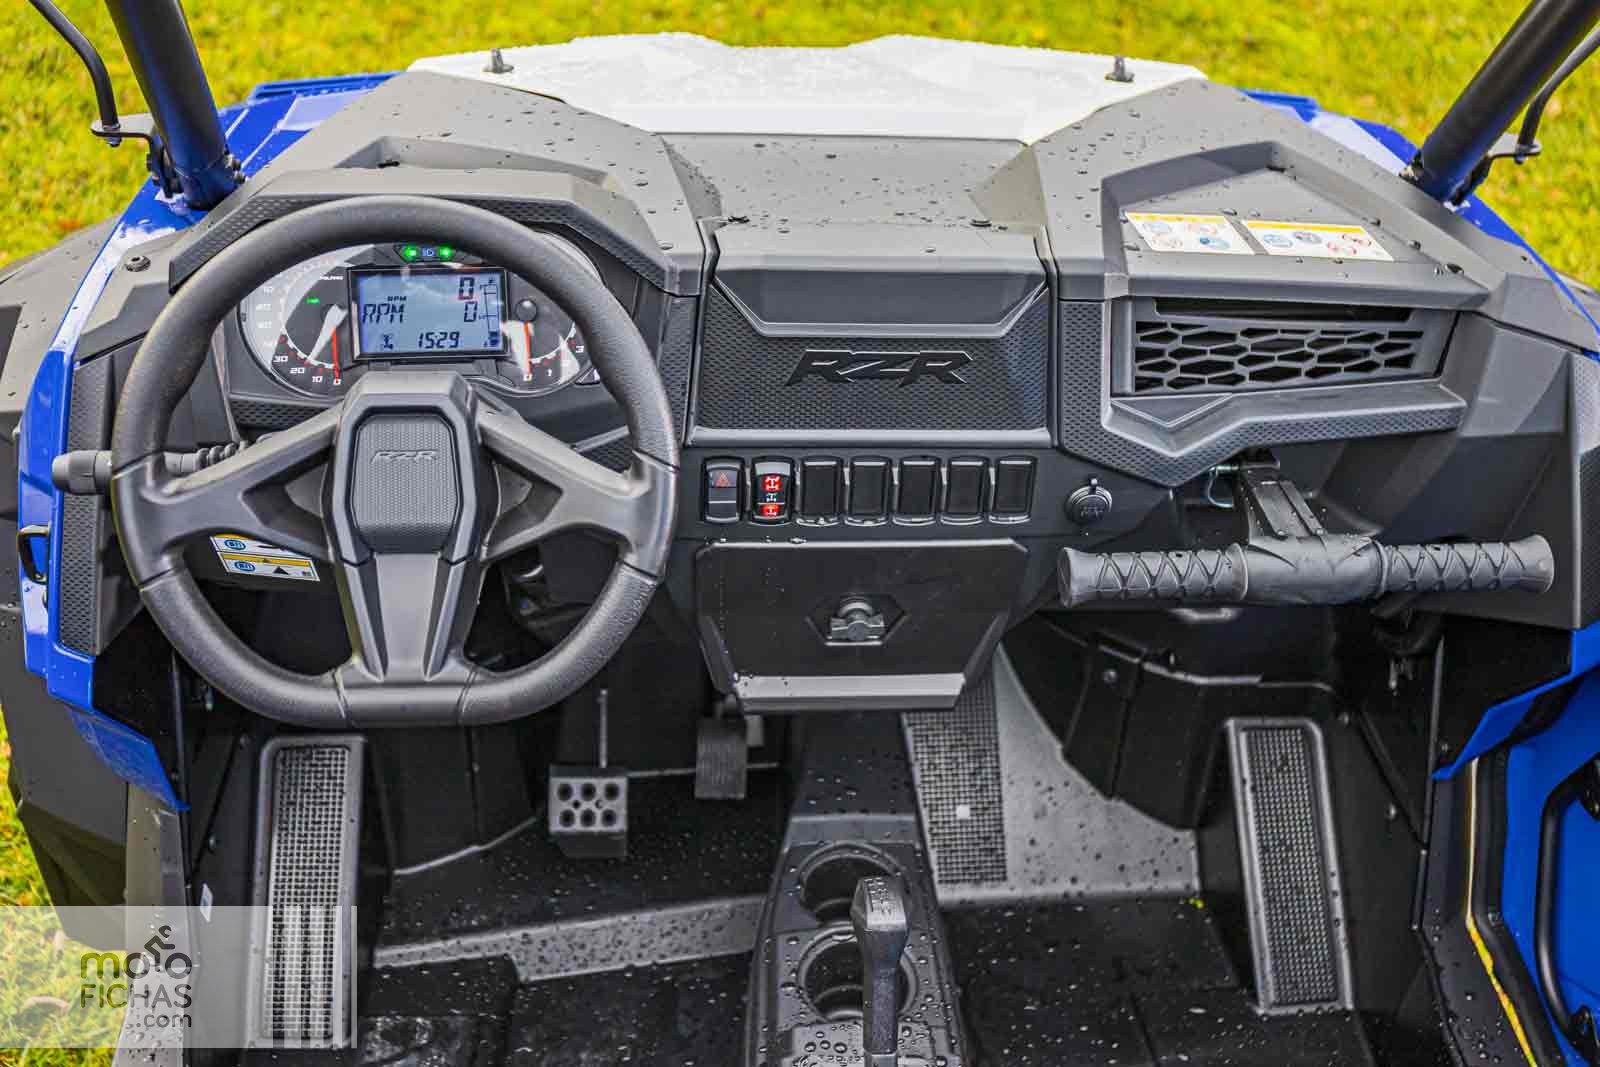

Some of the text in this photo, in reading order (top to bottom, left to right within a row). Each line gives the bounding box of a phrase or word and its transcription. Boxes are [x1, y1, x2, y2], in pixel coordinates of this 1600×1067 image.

[458, 277, 475, 300] 0
[362, 303, 405, 324] RPM
[463, 301, 478, 322] 0
[783, 349, 974, 387] RZR
[311, 375, 324, 383] 10
